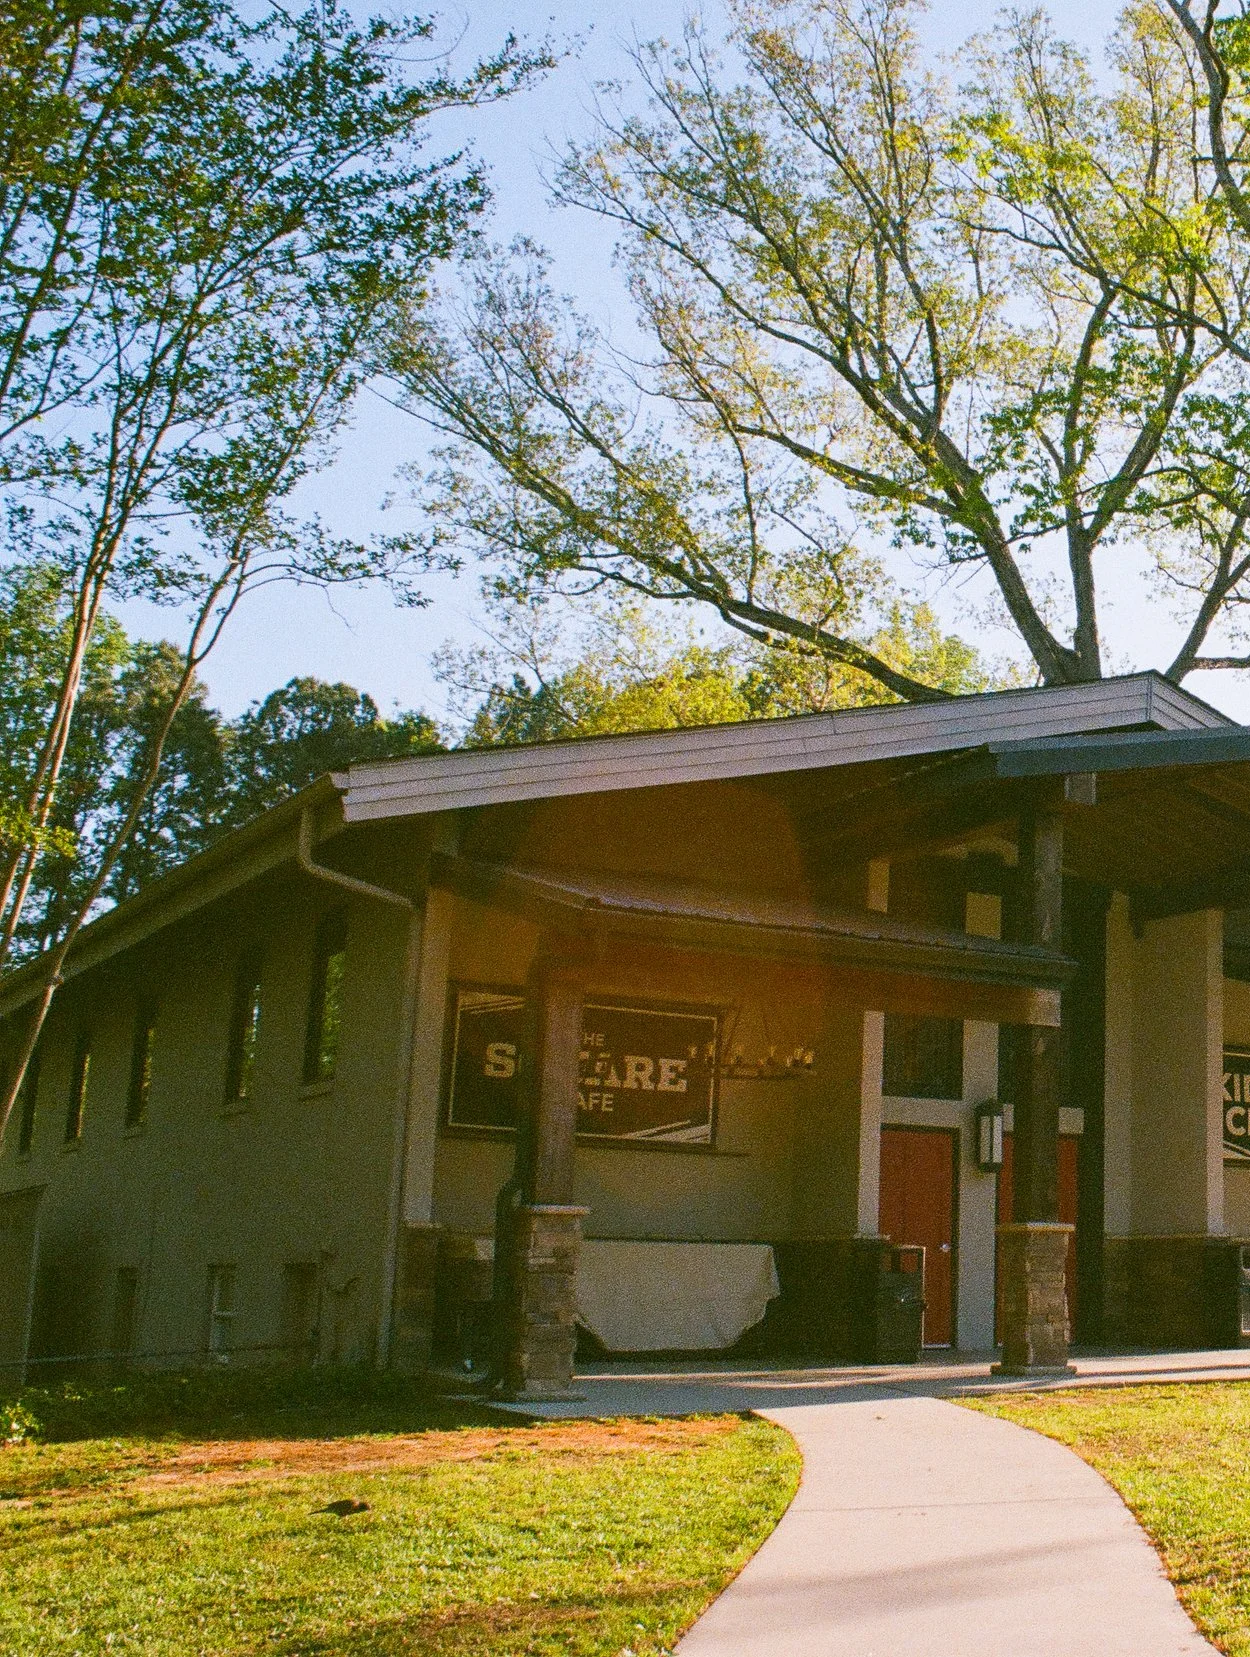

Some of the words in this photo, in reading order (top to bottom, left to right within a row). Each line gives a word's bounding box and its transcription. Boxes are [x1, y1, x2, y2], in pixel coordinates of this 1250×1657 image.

[581, 1032, 605, 1047] HE
[483, 1041, 688, 1093] SARE
[577, 1092, 614, 1112] AFE
